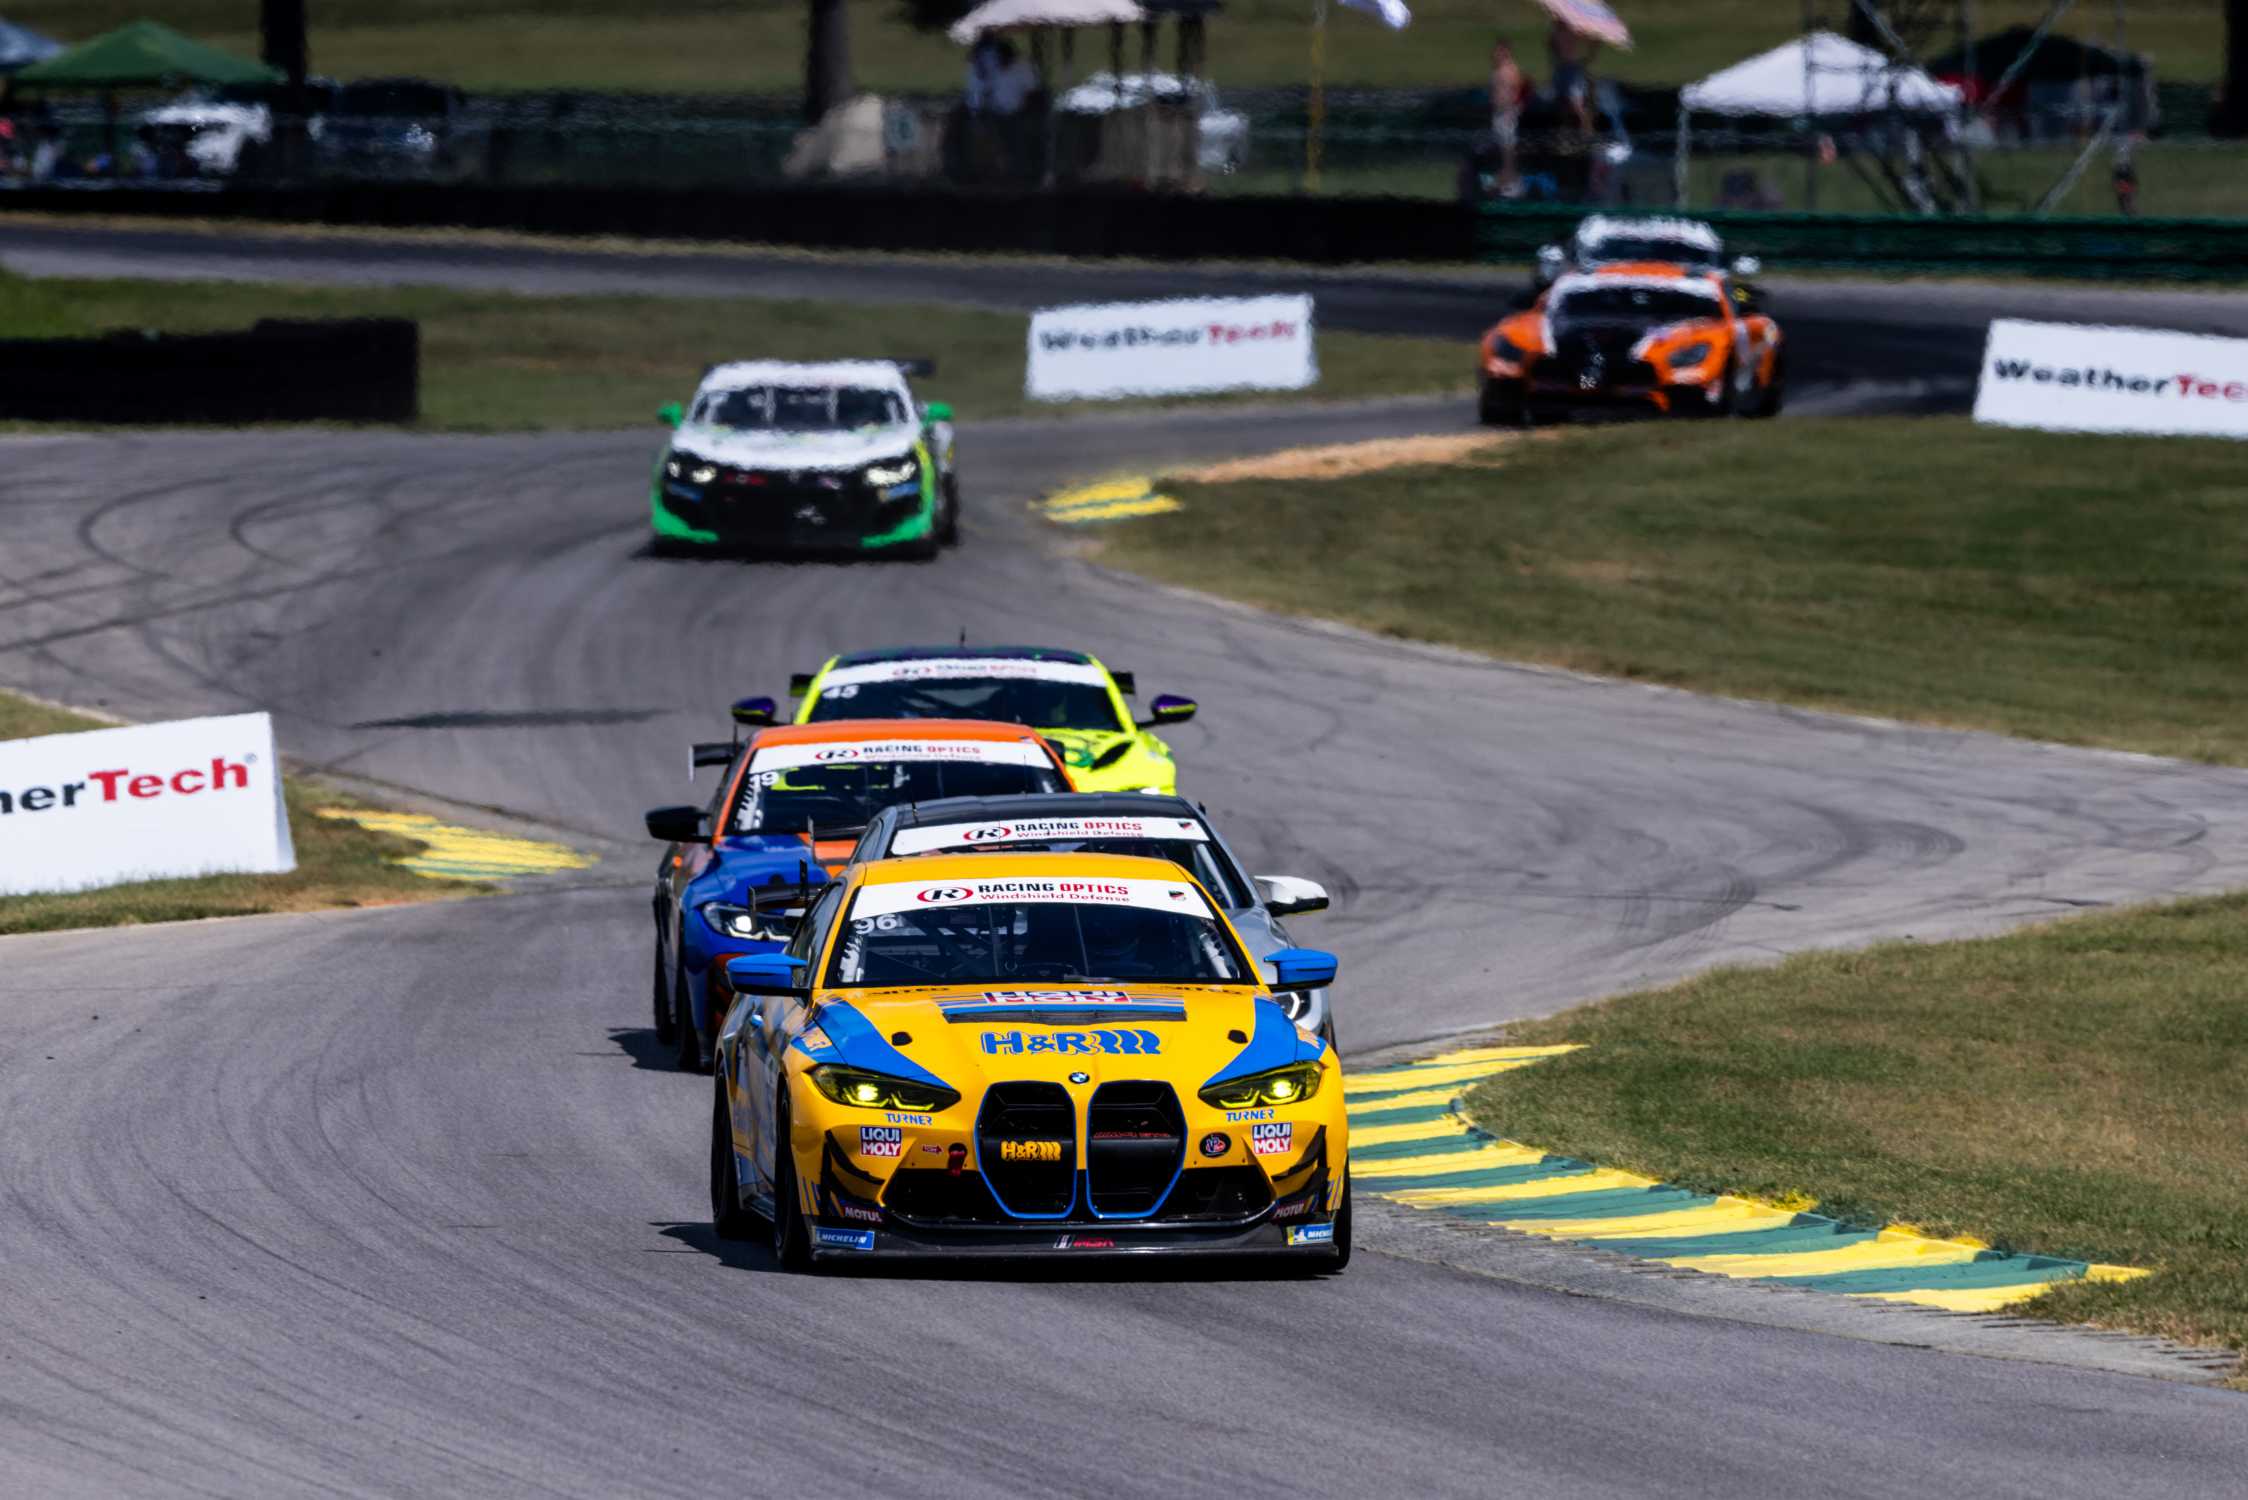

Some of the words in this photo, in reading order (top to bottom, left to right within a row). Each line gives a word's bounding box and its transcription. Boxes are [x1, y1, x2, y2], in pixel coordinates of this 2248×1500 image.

[1015, 821, 1080, 832] RACING
[1084, 821, 1143, 831] OPTICS
[978, 883, 1055, 893] RACING
[1059, 883, 1129, 895] OPTICS
[980, 892, 1065, 901] Windshield
[1069, 893, 1130, 902] Defense
[854, 913, 897, 935] 96
[884, 1112, 933, 1126] TURNER
[1226, 1109, 1275, 1121] TURNER
[861, 1127, 901, 1142] LIQUI
[1253, 1123, 1291, 1139] LIQUI
[862, 1142, 901, 1156] MOLY
[1254, 1138, 1291, 1153] MOLY
[845, 1206, 882, 1222] MOTUL
